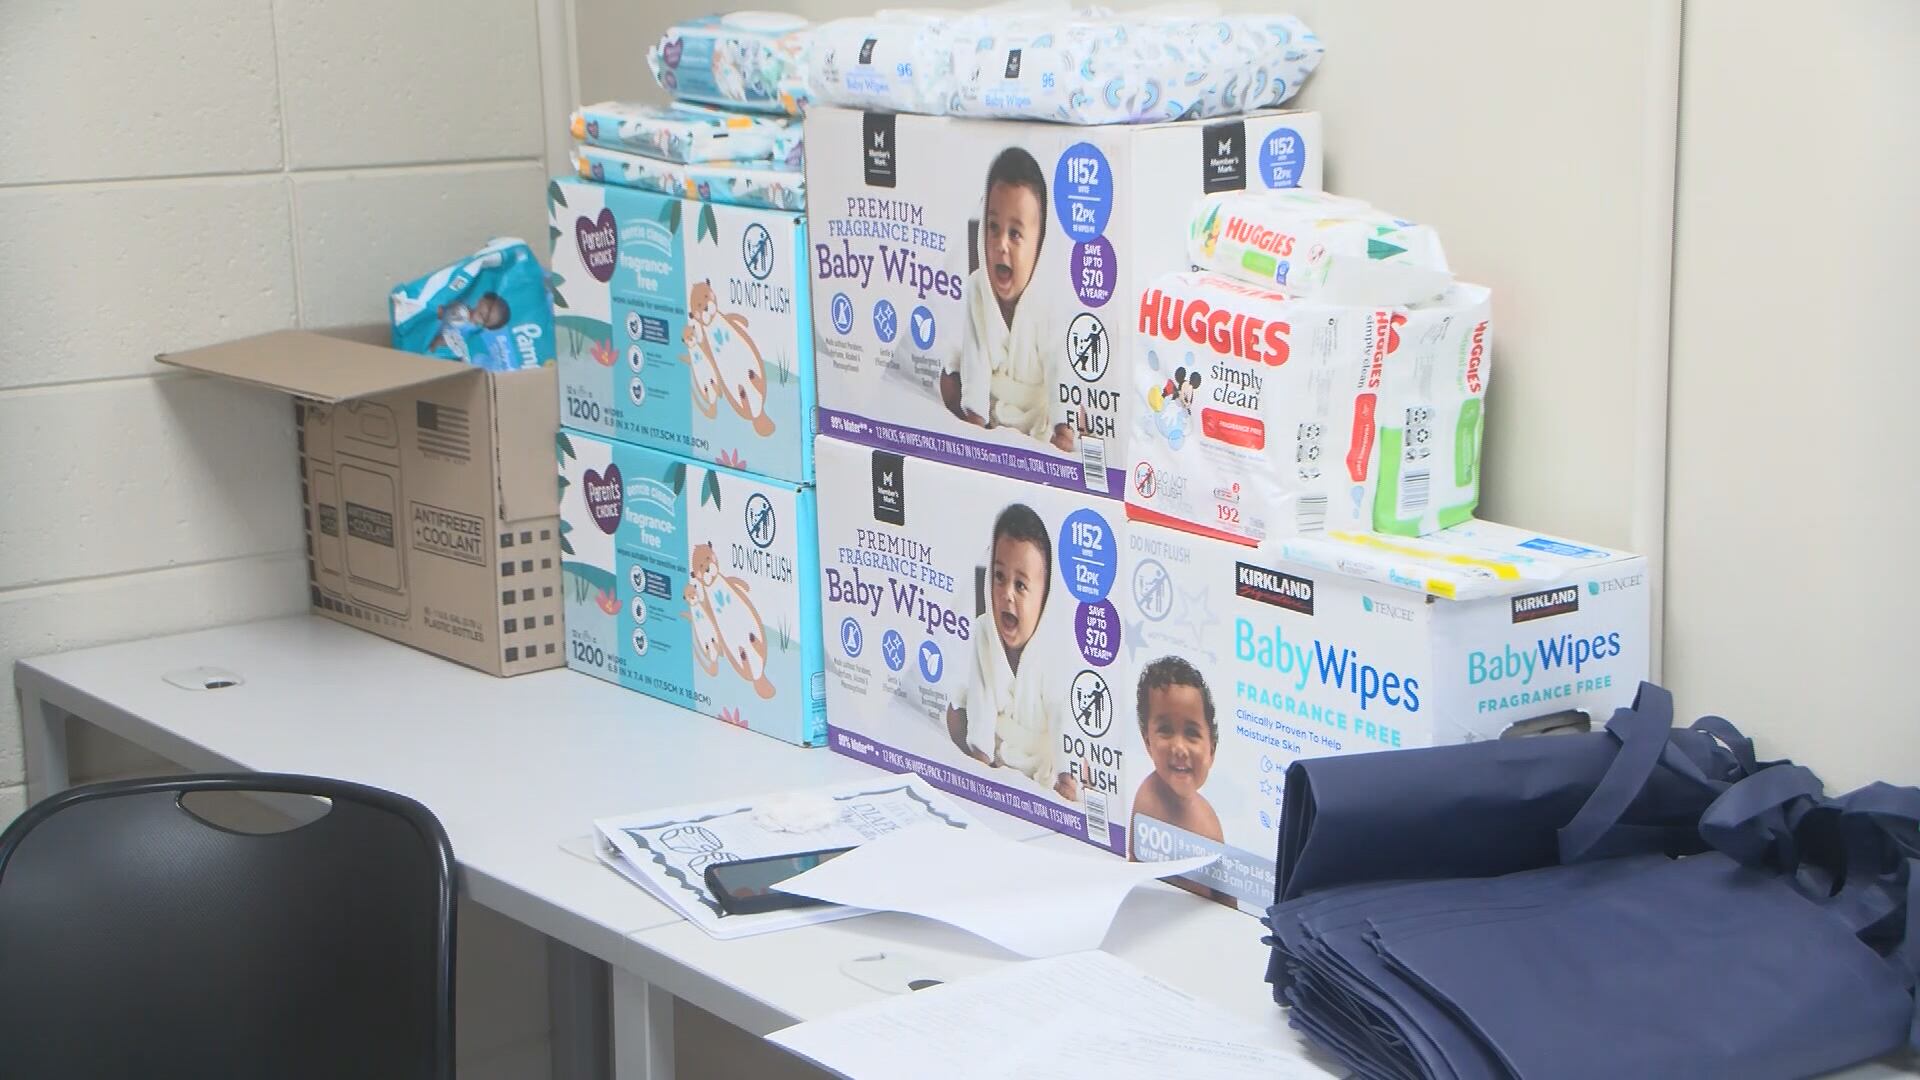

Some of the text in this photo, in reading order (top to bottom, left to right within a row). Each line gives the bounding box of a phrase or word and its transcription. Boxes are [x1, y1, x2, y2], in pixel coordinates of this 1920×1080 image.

[896, 63, 912, 77] 96
[1042, 73, 1054, 88] 96
[1269, 136, 1295, 156] 1152
[1066, 157, 1099, 185] 1152
[847, 197, 924, 226] PREMIUM
[581, 222, 615, 252] Parent's
[828, 220, 946, 252] FRAGRANCE FREE
[1084, 244, 1102, 256] SAVE
[1224, 216, 1296, 258] HUGGIES
[590, 248, 614, 268] CHOICE
[816, 239, 962, 300] Baby Wipes
[636, 271, 658, 292] free
[1082, 268, 1104, 288] $70
[730, 278, 790, 314] DO NOT FLUSH
[1138, 288, 1292, 366] HUGGIES
[1368, 312, 1389, 388] HUGGIES
[1466, 320, 1489, 394] HUGGIES
[1210, 361, 1263, 395] simply
[567, 396, 600, 422] 1200
[1058, 384, 1120, 412] DO NOT
[1212, 384, 1258, 410] clean
[1066, 410, 1116, 438] FLUSH
[588, 477, 620, 502] Parent's
[415, 508, 482, 536] ANTIFREEZE
[596, 503, 618, 518] CHOICE
[625, 506, 676, 534] fragrance-
[1218, 504, 1240, 523] 192
[640, 528, 662, 548] free
[857, 529, 932, 565] PREMIUM
[1072, 522, 1102, 550] 1152
[1130, 534, 1191, 564] DO NOT FLUSH
[732, 544, 792, 584] DO NOT FLUSH
[838, 548, 954, 592] FRAGRANCE FREE
[1076, 564, 1099, 586] 12PK
[1239, 566, 1312, 600] KIRKLAND
[825, 567, 970, 640] Baby Wipes
[1088, 605, 1106, 618] SAVE
[1514, 589, 1576, 612] KIRKLAND
[1086, 616, 1107, 630] UP TO
[1086, 627, 1108, 648] $70
[572, 640, 604, 668] 1200
[1478, 676, 1612, 714] FRAGRANCE FREE
[1236, 681, 1402, 748] FRAGRANCE FREE
[1236, 708, 1342, 750] Clinically Proven To Help
[1236, 726, 1301, 754] Moisturize Skin
[1063, 734, 1122, 770] DO NOT
[1070, 760, 1118, 795] FLUSH
[1138, 822, 1172, 854] 900
[1250, 865, 1264, 880] Lid
